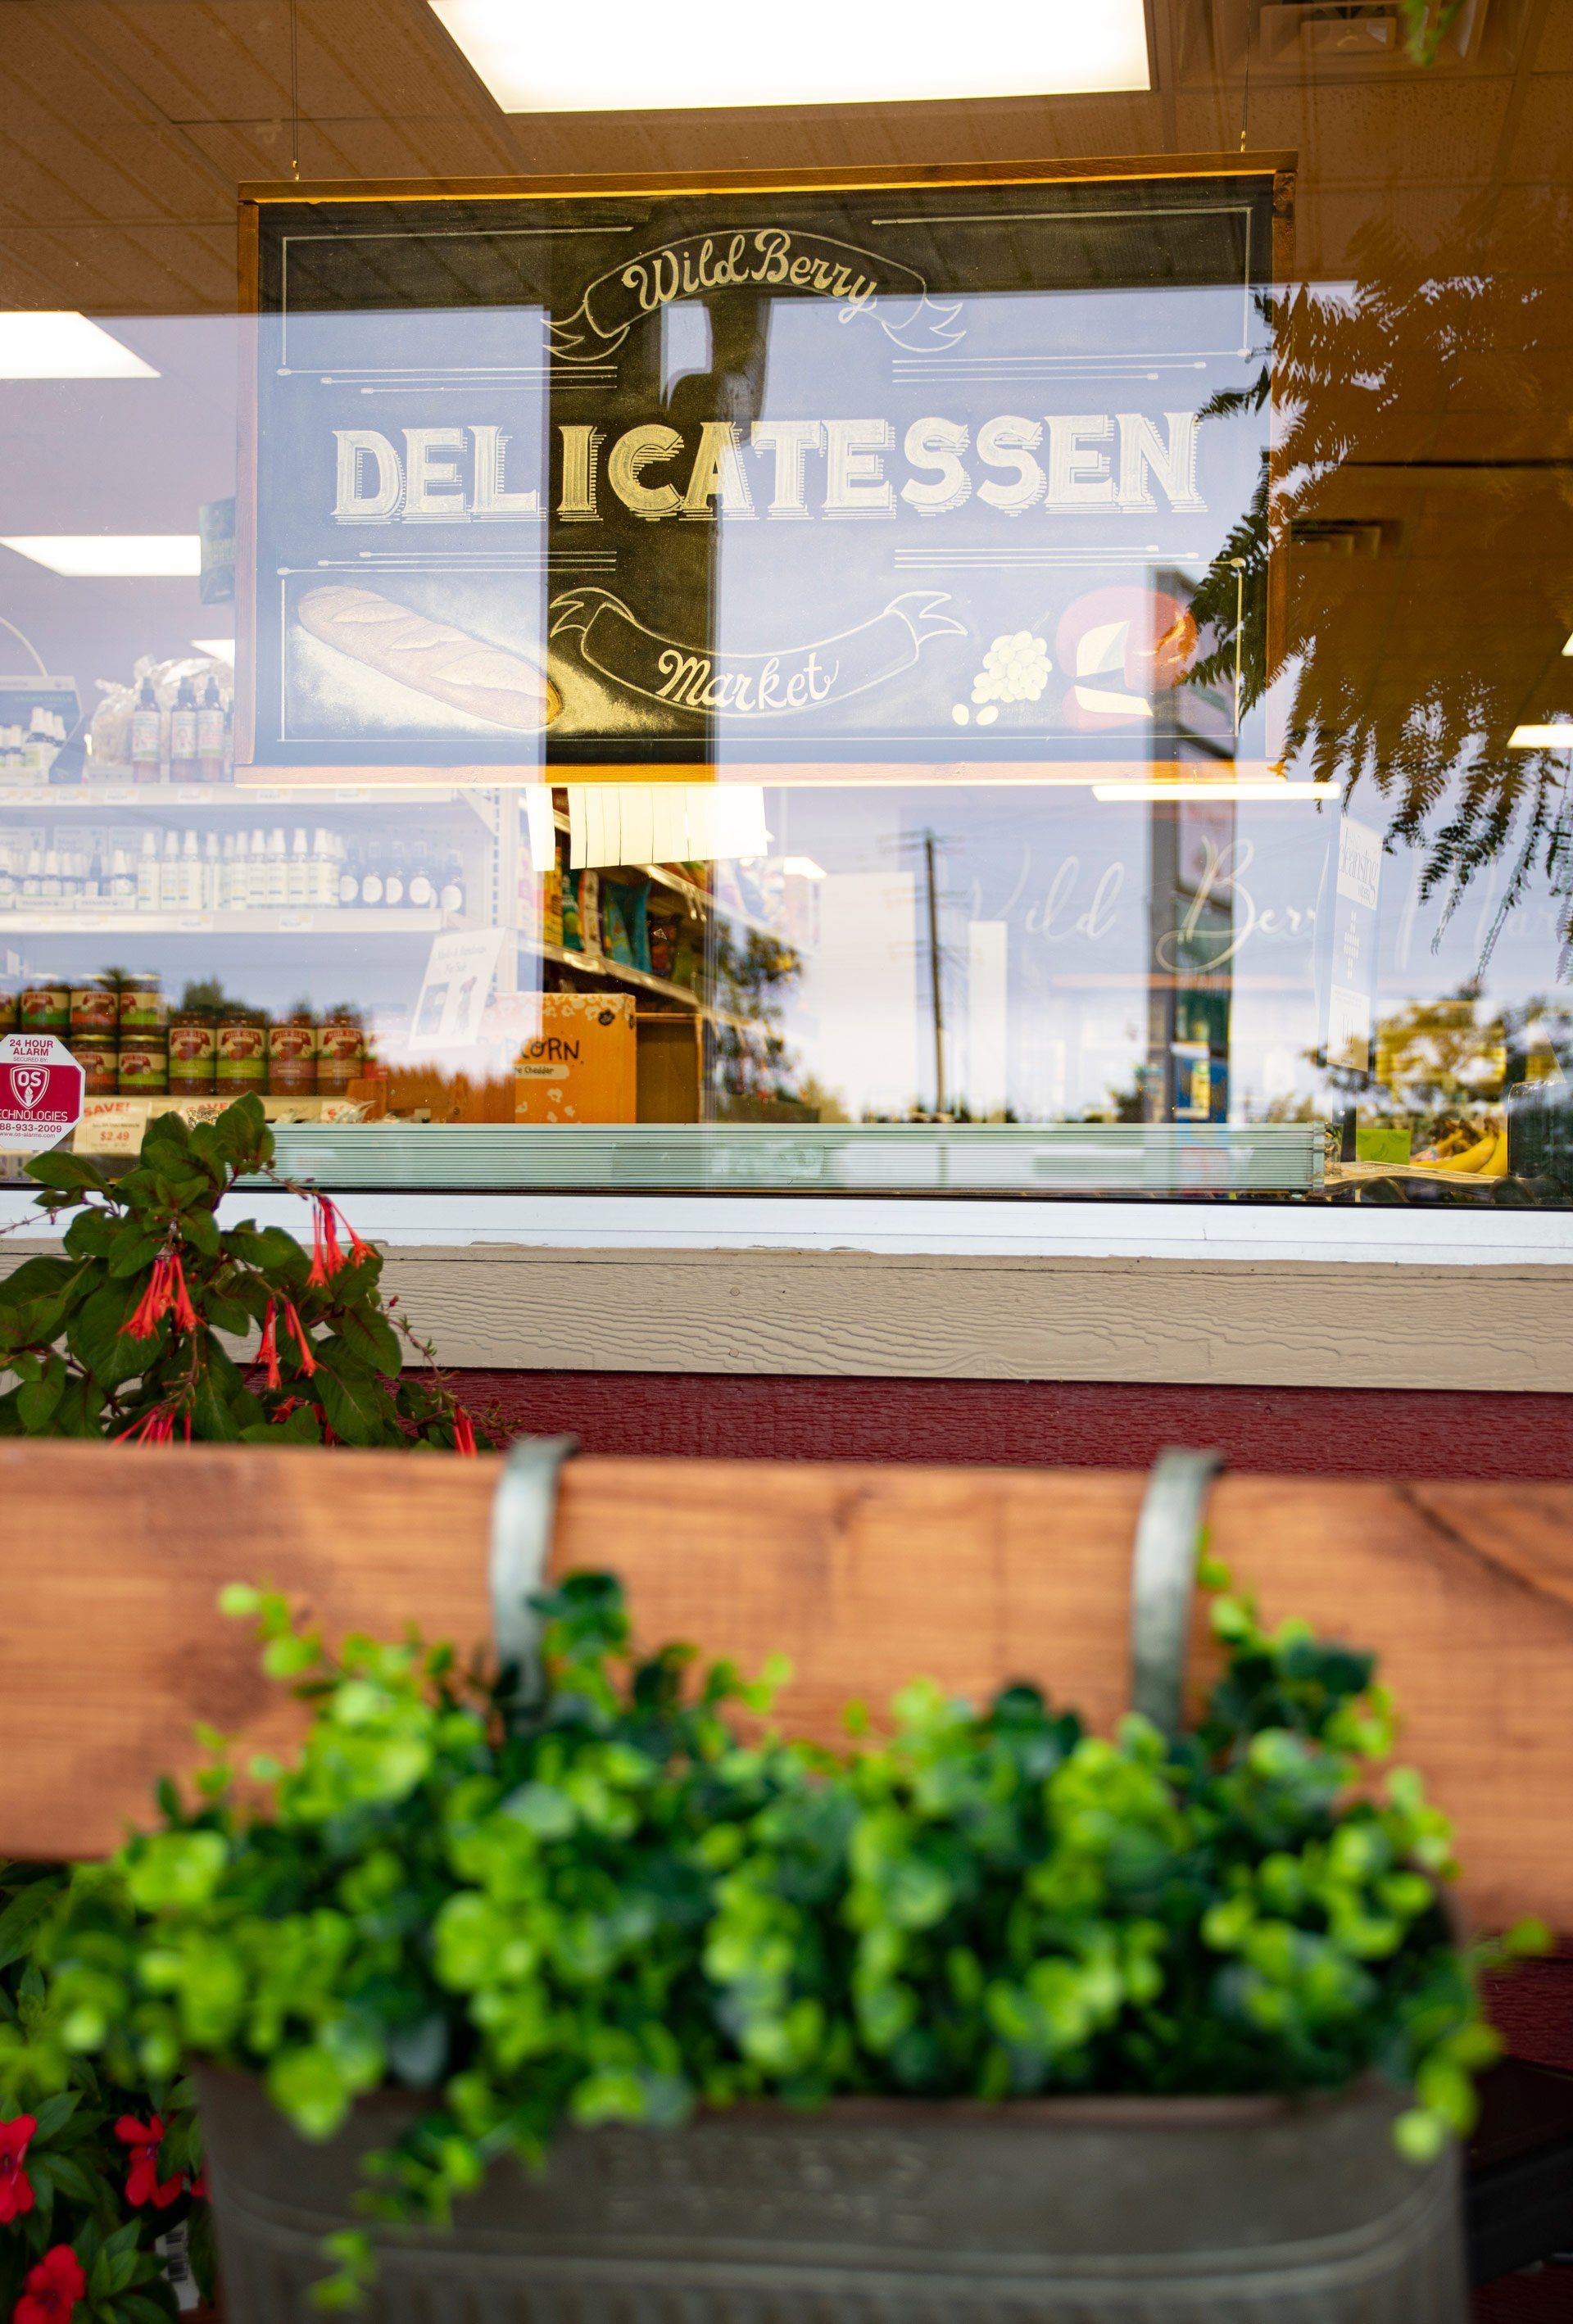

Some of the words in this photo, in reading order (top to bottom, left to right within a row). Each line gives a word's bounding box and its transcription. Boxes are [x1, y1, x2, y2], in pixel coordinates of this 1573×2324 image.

[623, 234, 749, 310] Wild
[750, 229, 877, 324] Berry
[330, 412, 1208, 524] DELICATESSEN
[655, 649, 840, 712] Market
[1155, 836, 1317, 975] Berr
[10, 1039, 21, 1047] 24
[25, 1040, 53, 1049] HOUR
[13, 1048, 49, 1056] ALARM
[18, 1071, 42, 1087] OS
[100, 1130, 130, 1142] $2.49
